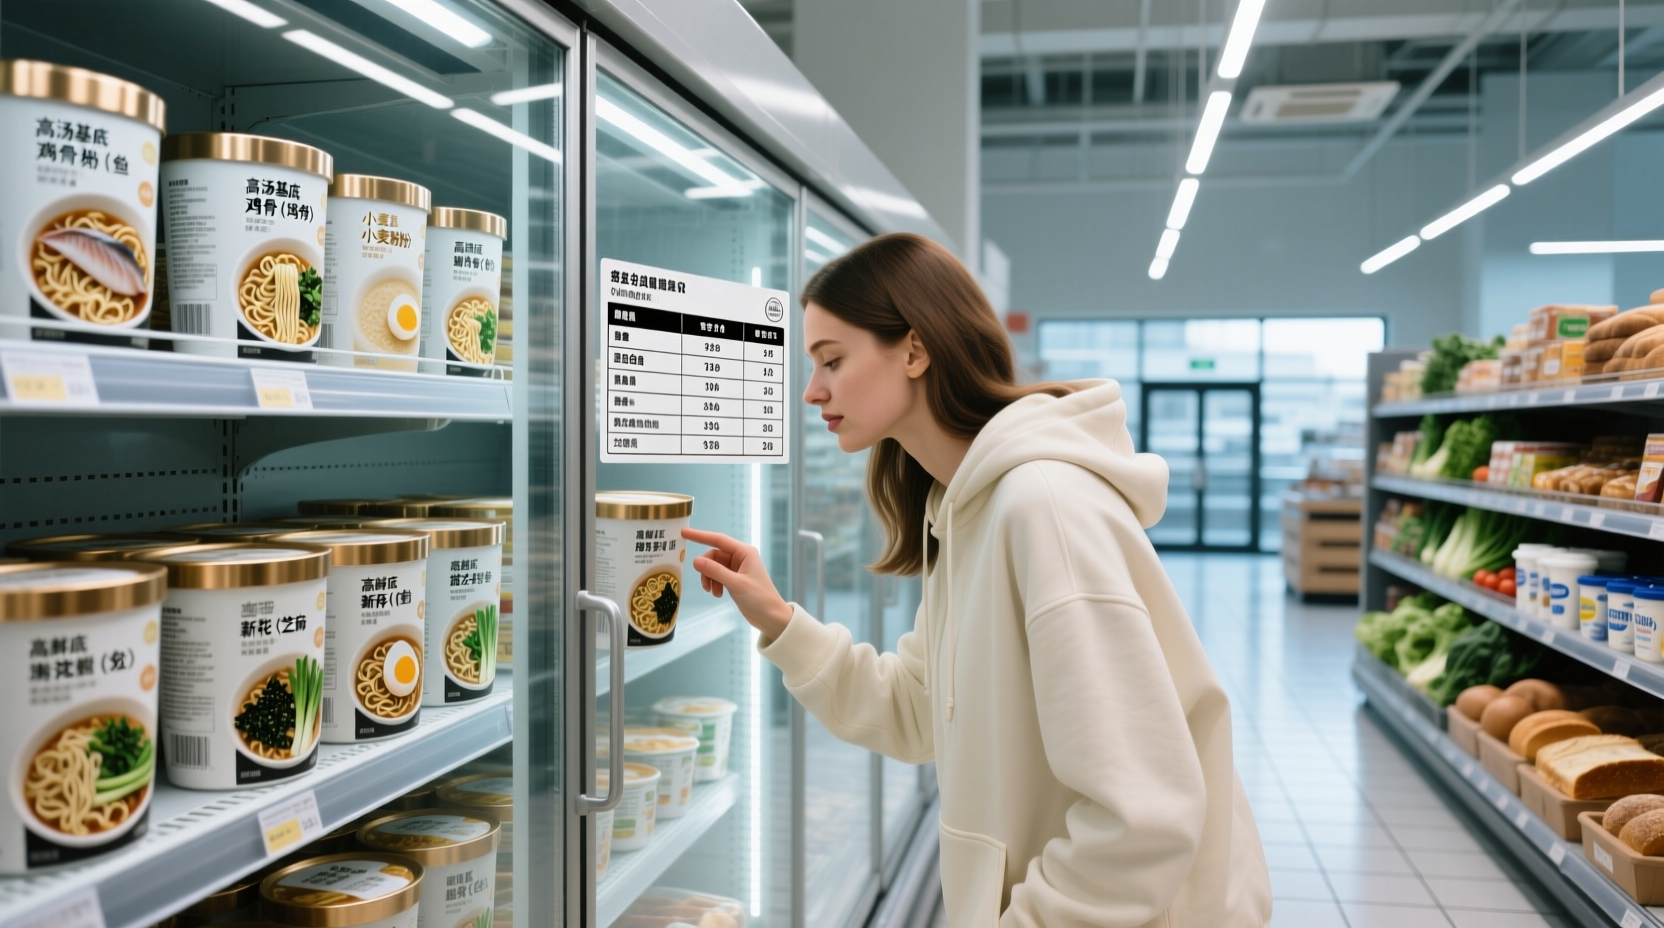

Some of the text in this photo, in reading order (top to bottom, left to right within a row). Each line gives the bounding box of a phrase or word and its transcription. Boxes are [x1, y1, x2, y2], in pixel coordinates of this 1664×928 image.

[36, 117, 109, 146] 高汤基底
[246, 178, 301, 200] 高汤基底
